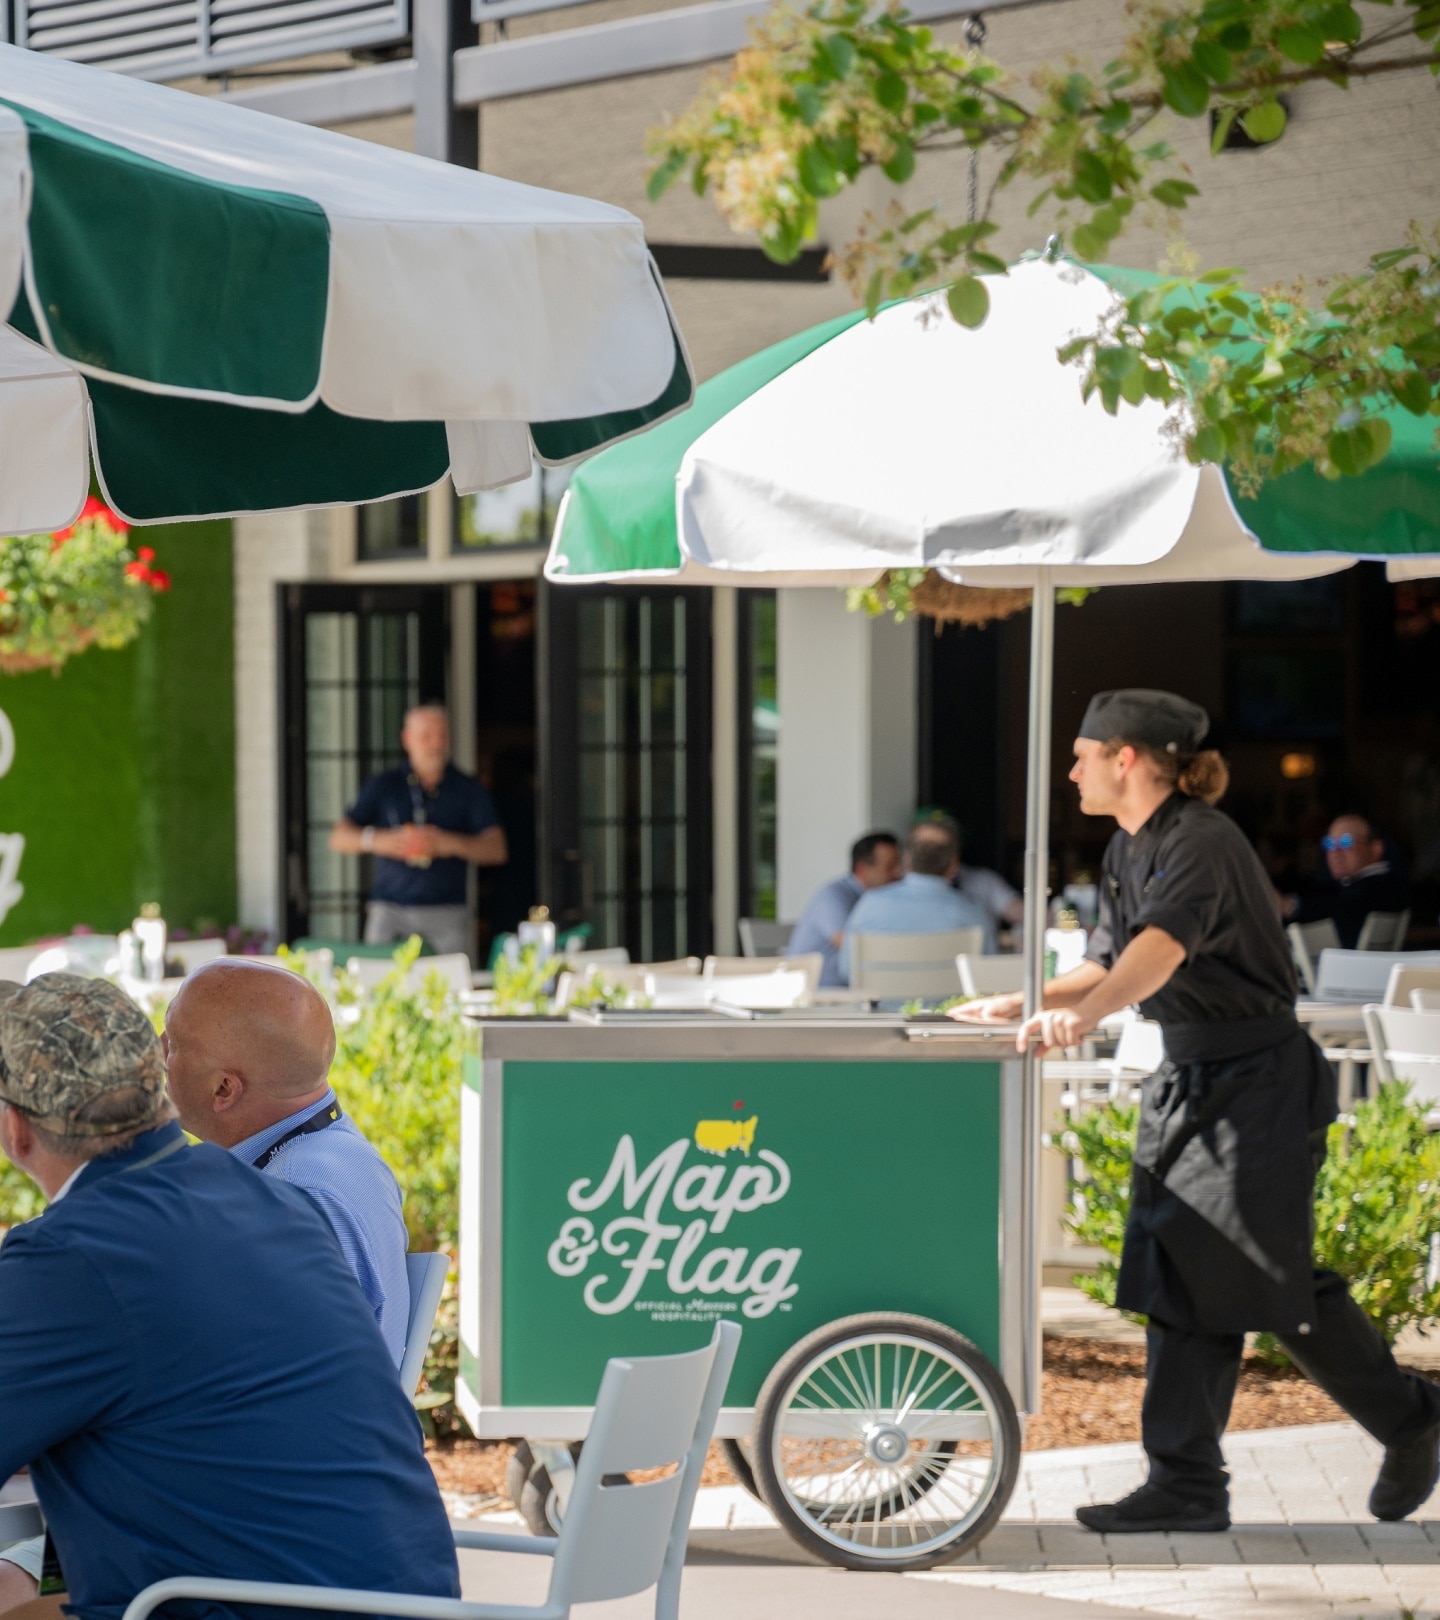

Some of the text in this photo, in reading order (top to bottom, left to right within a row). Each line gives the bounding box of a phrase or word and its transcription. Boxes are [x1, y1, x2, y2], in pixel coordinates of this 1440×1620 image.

[567, 1133, 791, 1234] Map
[547, 1216, 803, 1319] & Flag
[633, 1301, 682, 1312] OFFICIAL
[651, 1311, 722, 1321] HOSPITALITY
